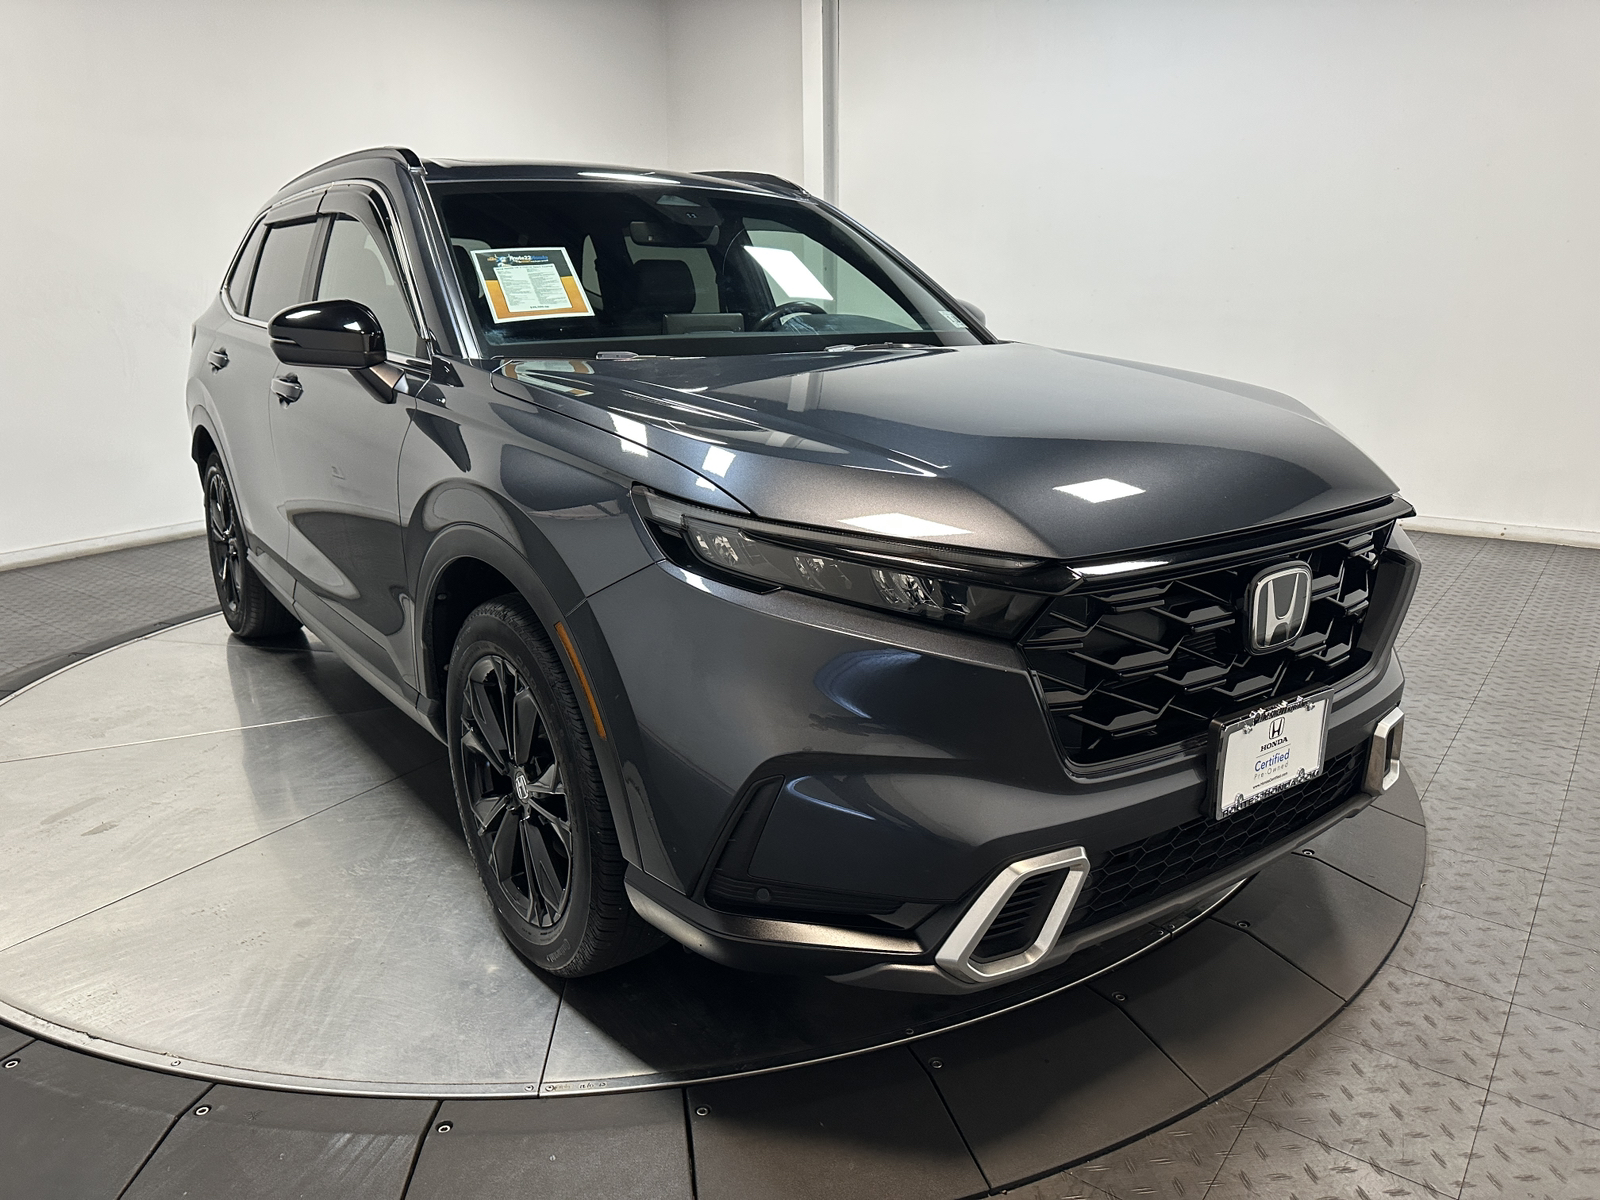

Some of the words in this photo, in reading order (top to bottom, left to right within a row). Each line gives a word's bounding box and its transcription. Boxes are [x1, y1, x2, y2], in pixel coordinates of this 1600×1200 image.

[1260, 737, 1288, 752] HONDA
[1254, 749, 1290, 772] Certified
[1254, 762, 1289, 780] Pre-Owned
